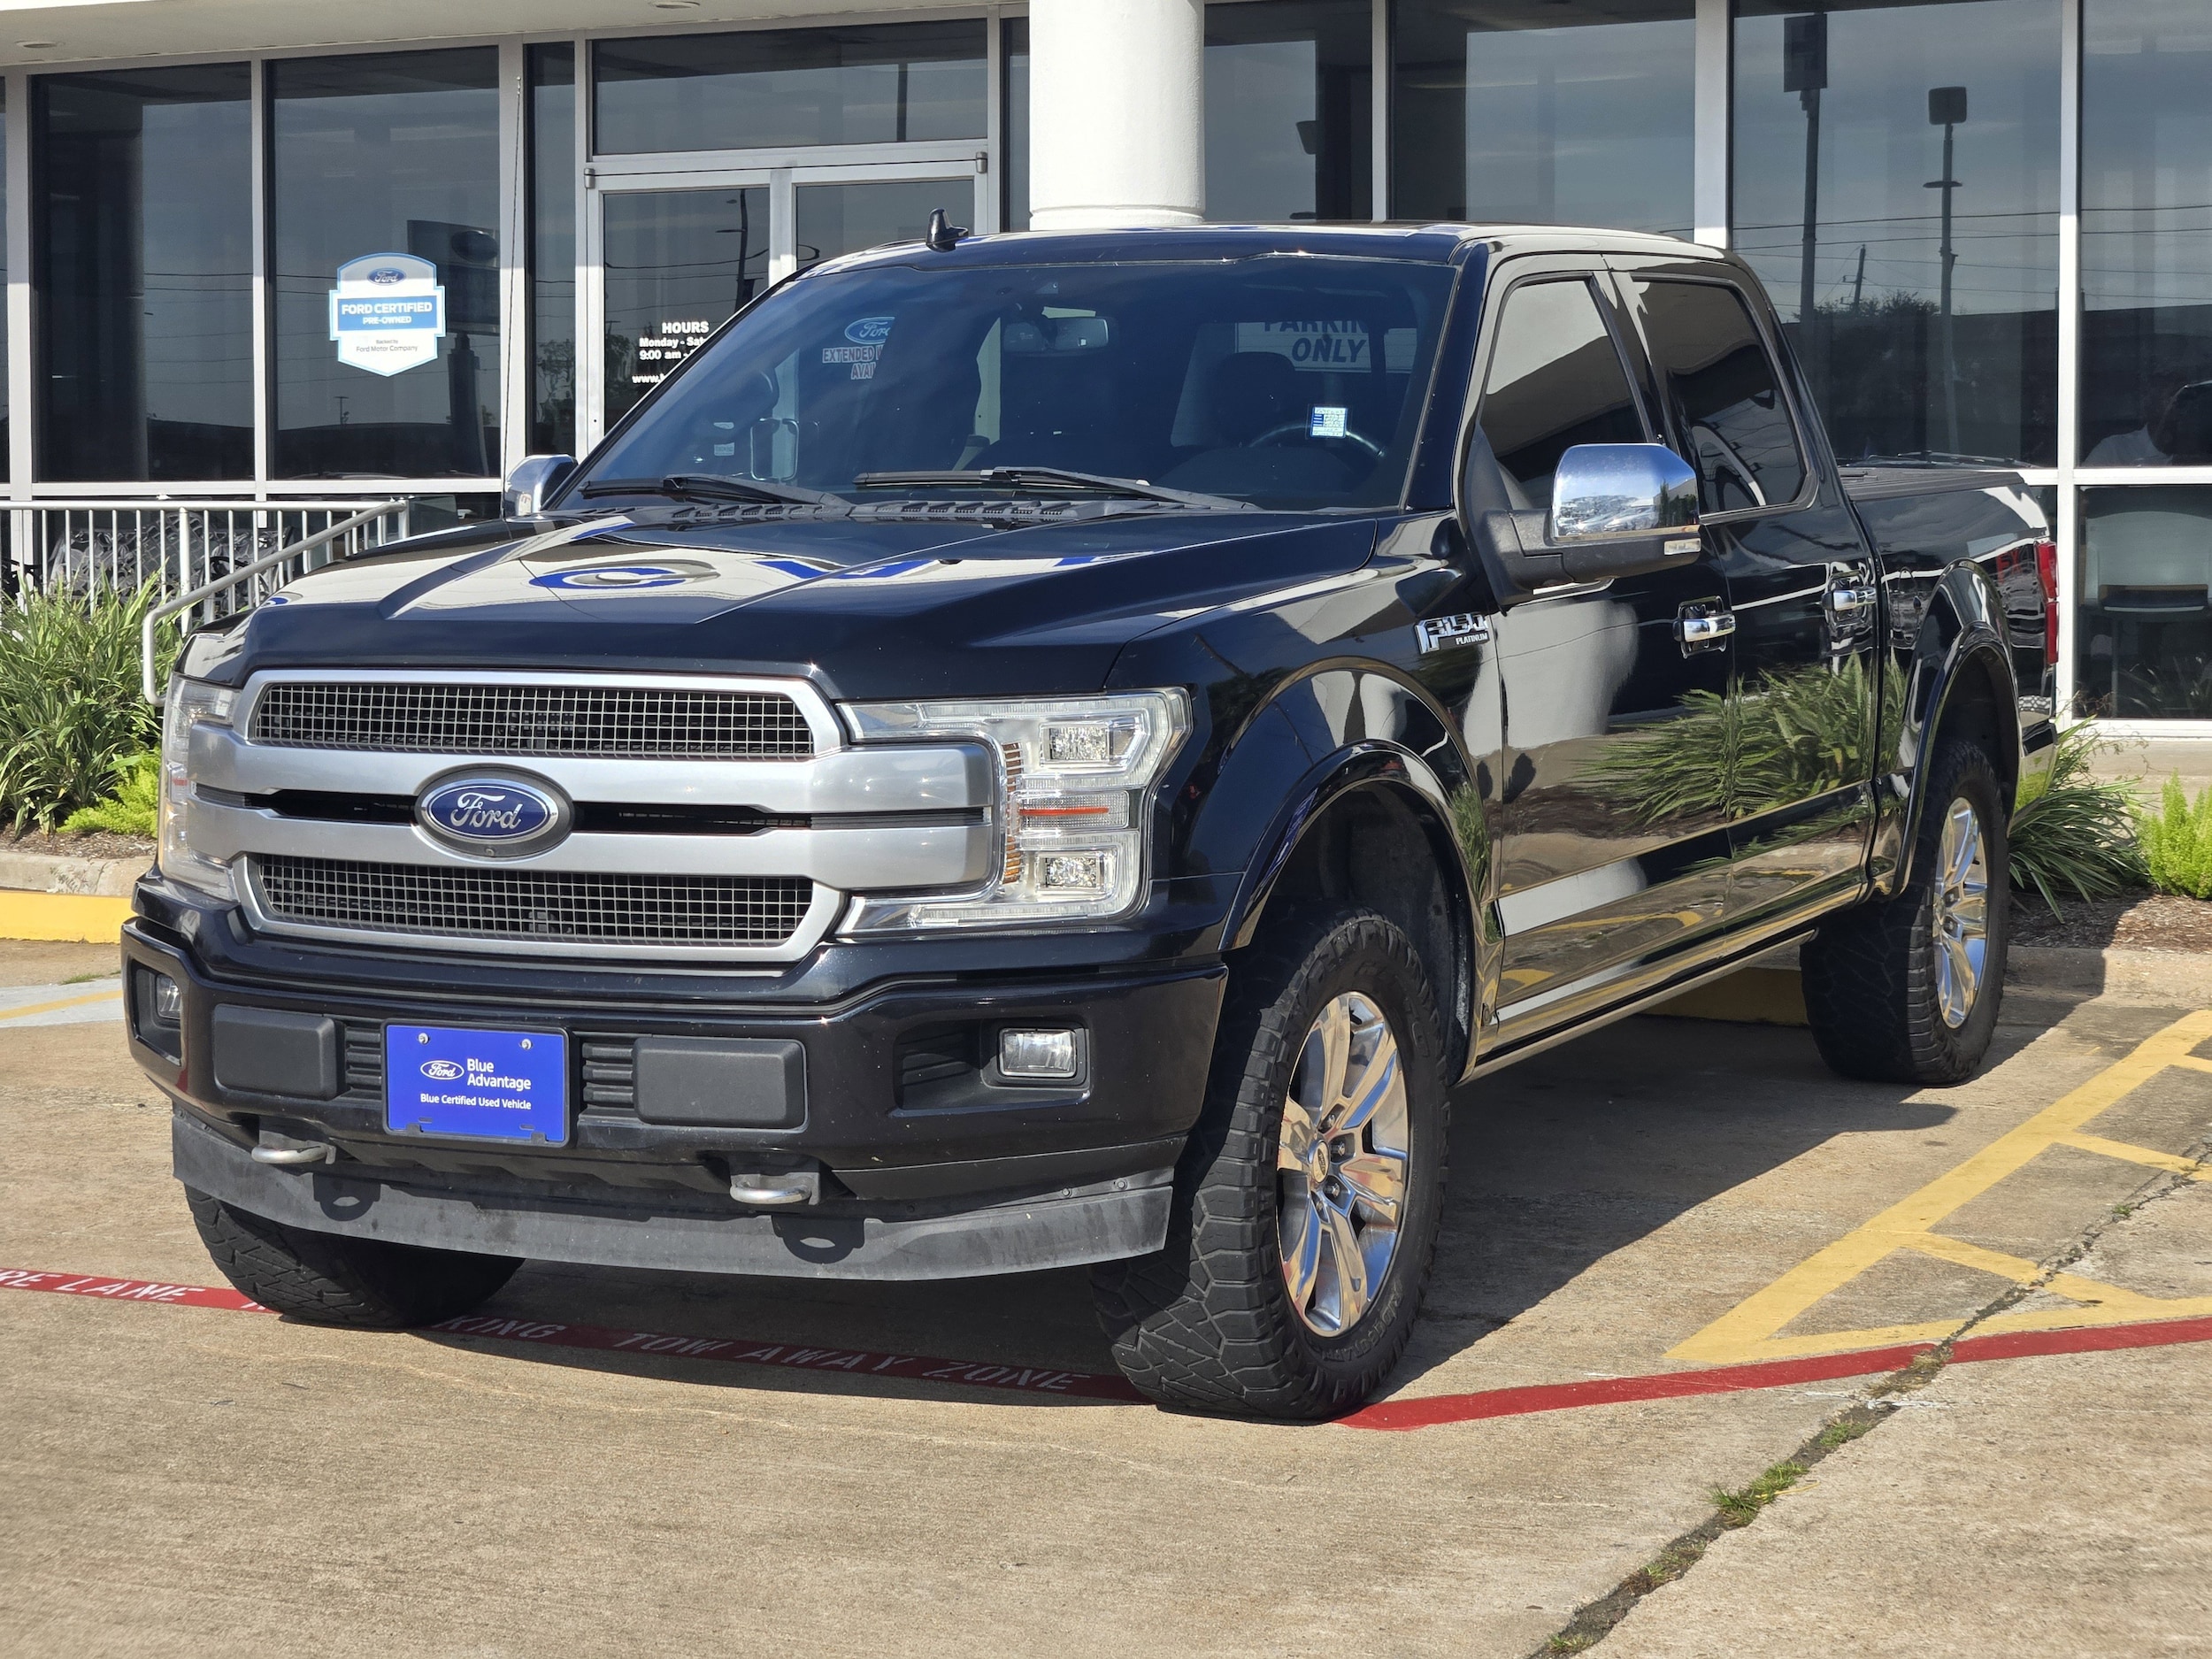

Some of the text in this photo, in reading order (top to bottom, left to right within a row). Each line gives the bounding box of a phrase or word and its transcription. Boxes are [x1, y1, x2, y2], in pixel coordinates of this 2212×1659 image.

[374, 270, 399, 283] Ford
[342, 302, 433, 315] FORD CERTIFIED
[363, 316, 412, 325] PRE-OWNED
[662, 321, 710, 334] HOURS
[639, 337, 679, 349] Monday
[1292, 337, 1367, 363] ONLY
[640, 349, 662, 360] 9:00
[822, 346, 875, 363] EXTENDED
[851, 362, 876, 380] AVAI
[1455, 632, 1488, 645] PLATINUM
[449, 792, 524, 829] Ford
[428, 1058, 495, 1079] Ford Blue
[467, 1073, 532, 1092] Advantage
[420, 1094, 532, 1110] Blue Certified Used Vehicle
[0, 1269, 1091, 1391] RE LANE KING TOW AWAY ZONE
